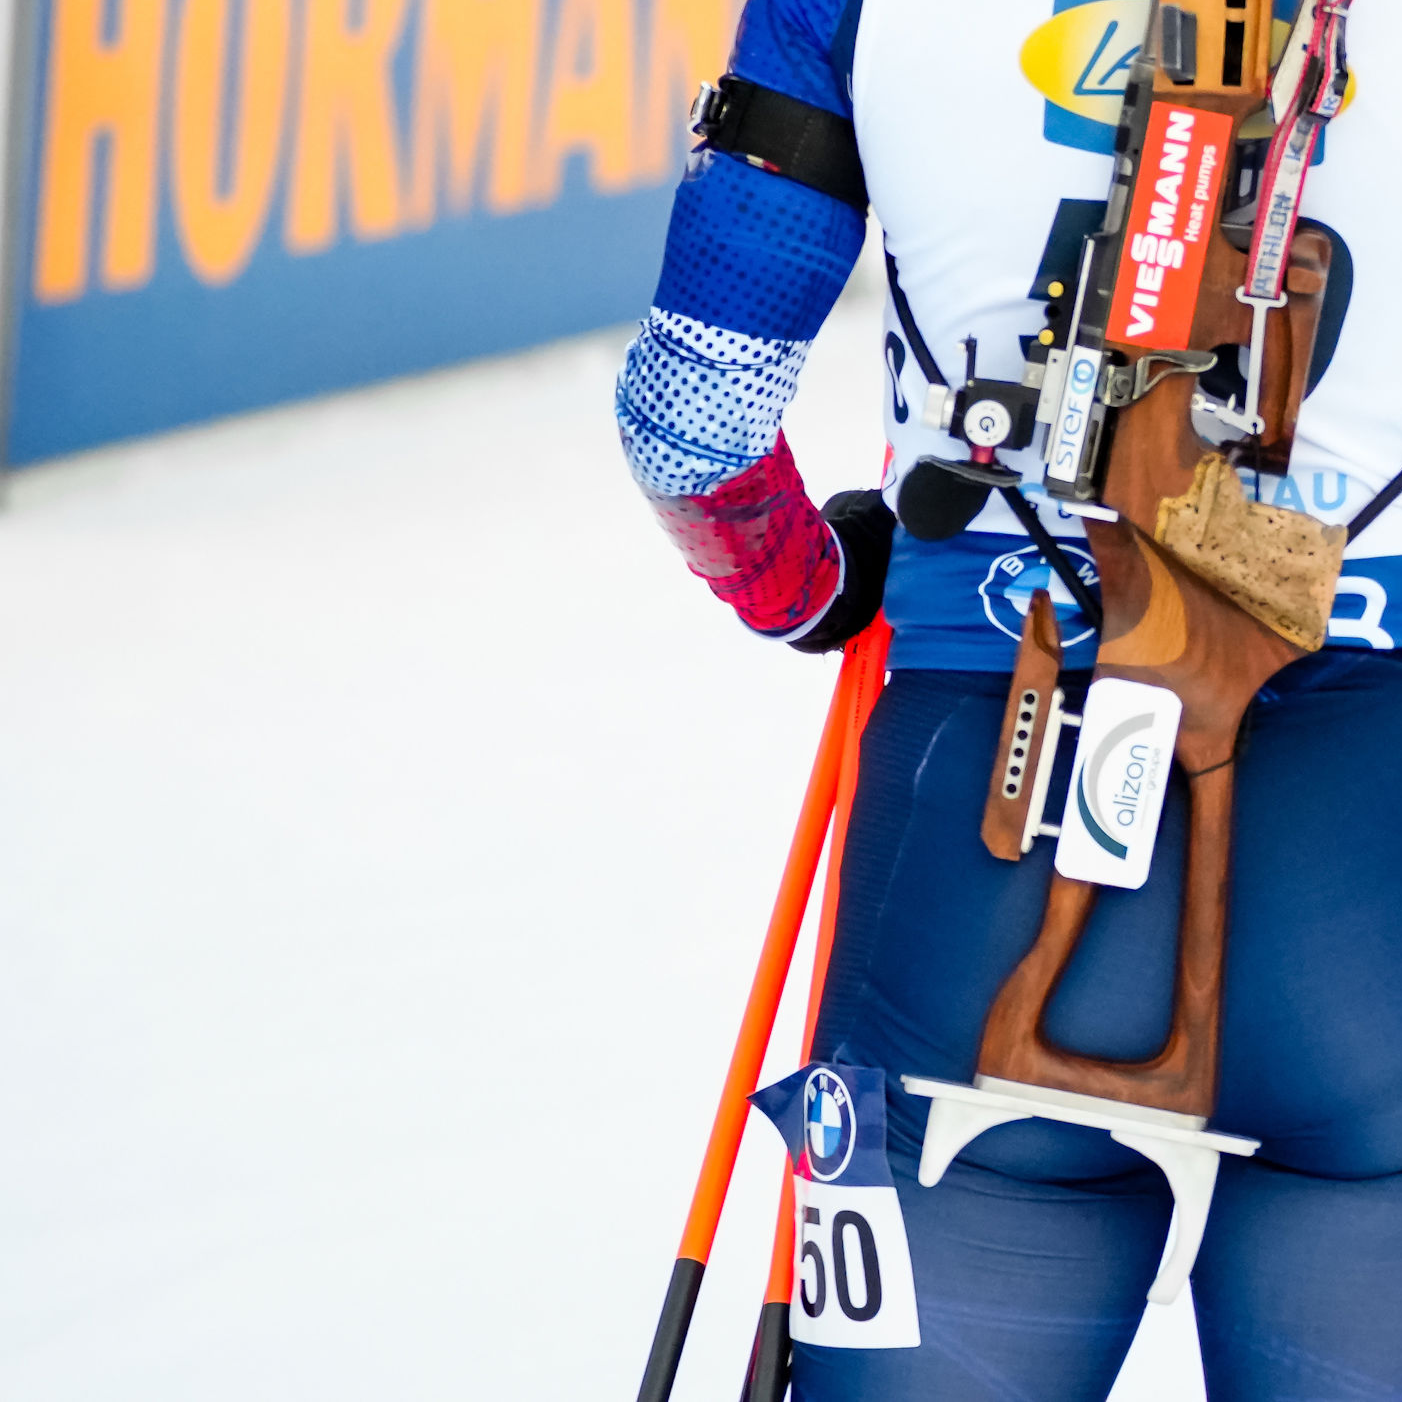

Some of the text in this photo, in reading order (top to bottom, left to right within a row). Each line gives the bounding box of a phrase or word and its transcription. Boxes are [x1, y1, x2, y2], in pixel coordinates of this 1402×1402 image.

[1126, 111, 1196, 338] VIESSMANN
[1183, 144, 1218, 243] Heat pumps
[1113, 744, 1149, 827] alizon
[807, 1073, 847, 1107] BMW
[799, 1204, 883, 1322] 50
